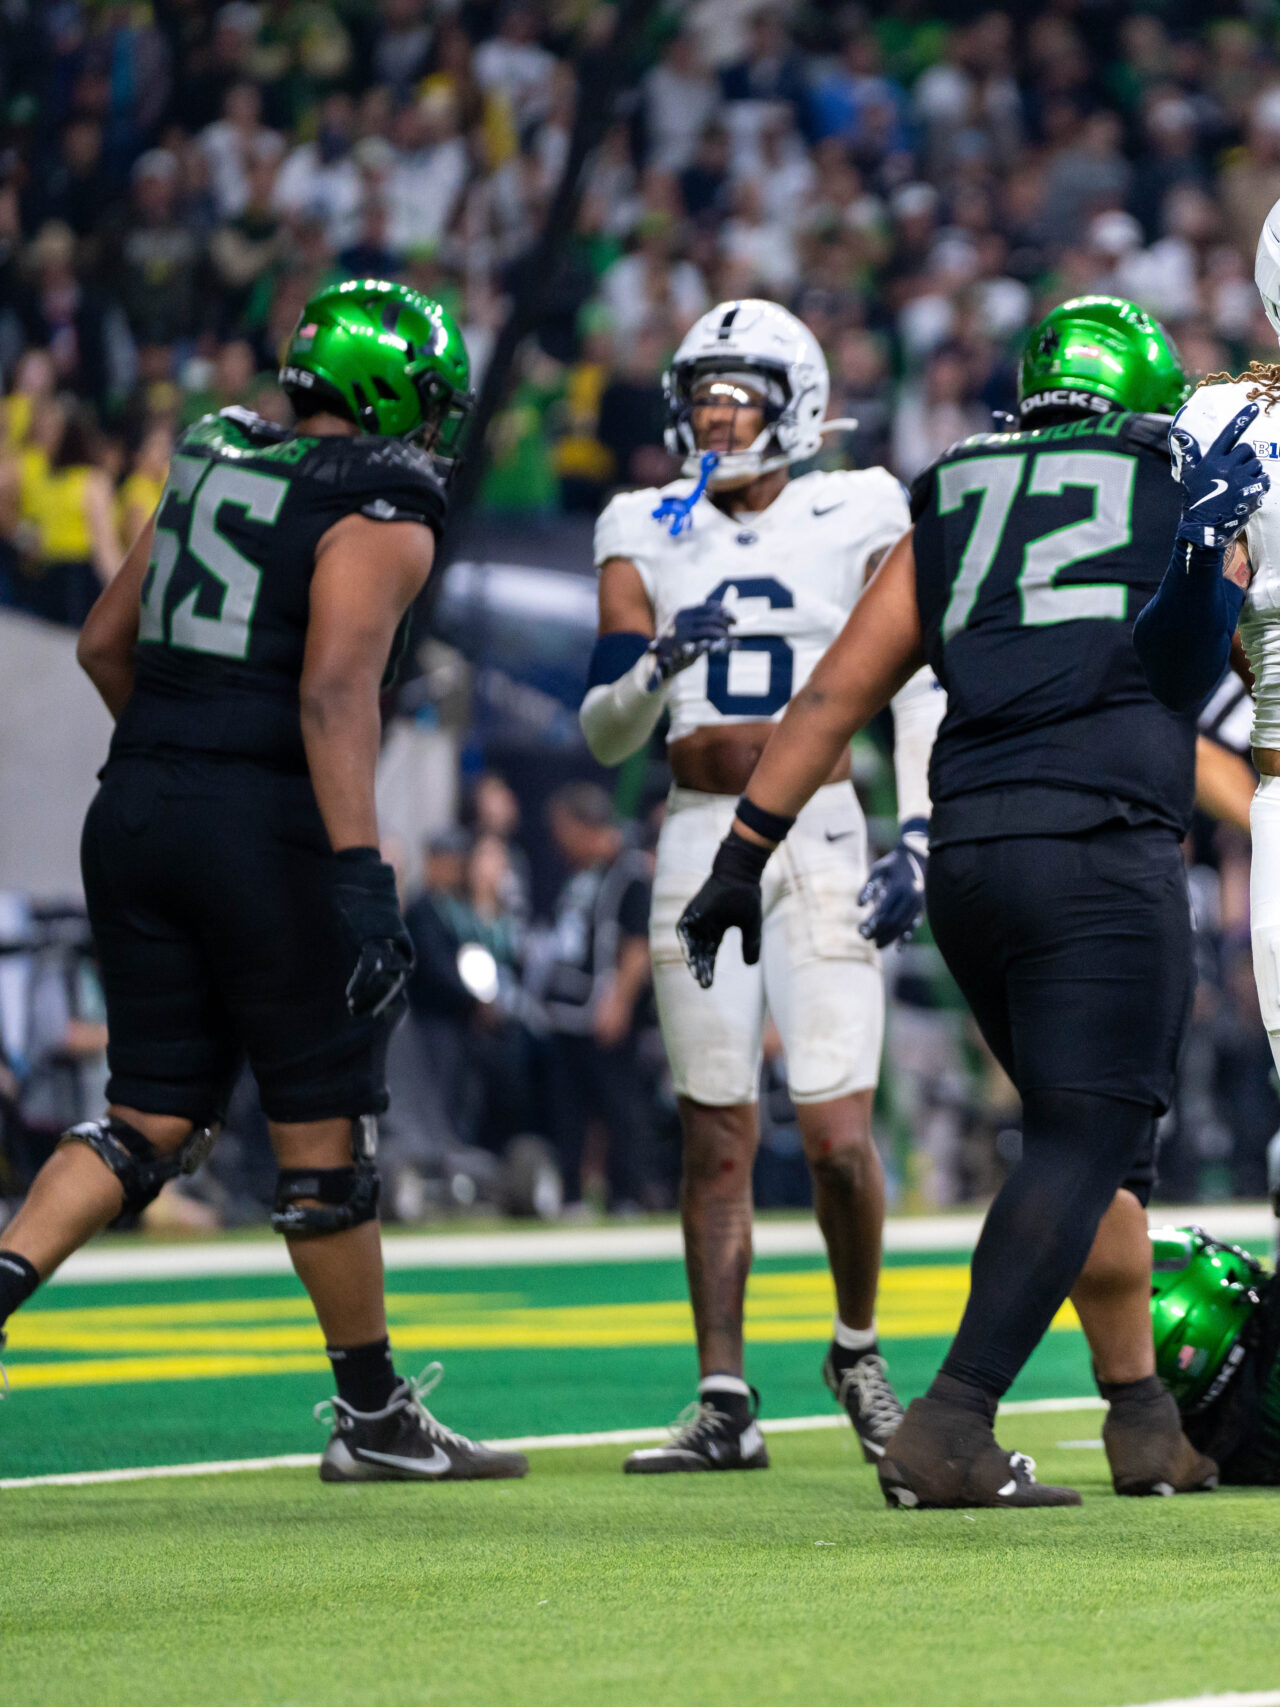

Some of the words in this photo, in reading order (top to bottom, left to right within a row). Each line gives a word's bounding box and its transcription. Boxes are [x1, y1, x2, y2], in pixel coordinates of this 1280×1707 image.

[1020, 390, 1112, 414] DUCKS
[937, 447, 1138, 643] 72
[705, 576, 794, 716] 6
